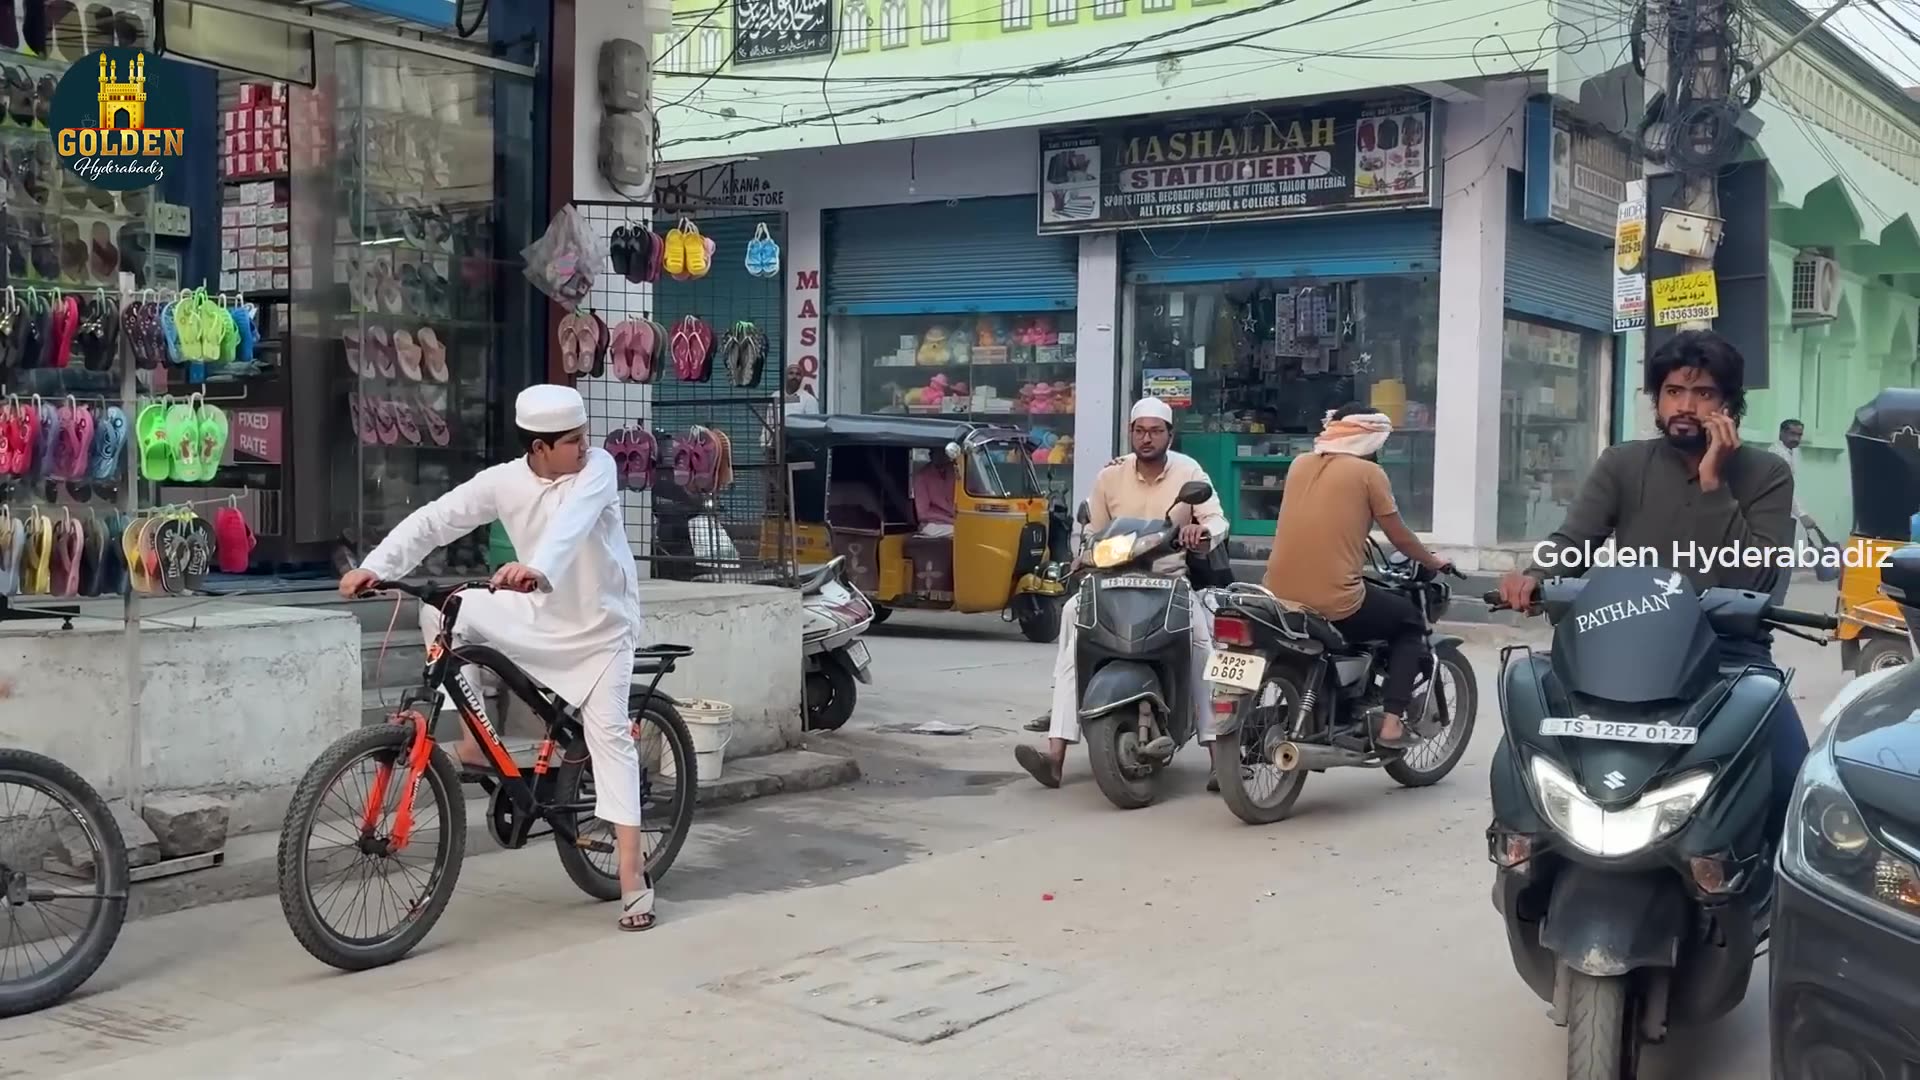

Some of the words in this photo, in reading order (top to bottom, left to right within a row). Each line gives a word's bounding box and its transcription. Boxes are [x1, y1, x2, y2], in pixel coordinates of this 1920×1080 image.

[1115, 117, 1337, 166] MASHALLAH
[752, 191, 784, 207] STORE
[1158, 188, 1204, 203] DECORATION
[1232, 184, 1250, 197] GIFT
[1307, 176, 1346, 190] MATERIAL
[1139, 205, 1154, 217] ALL
[1155, 203, 1182, 216] TYPES
[1183, 202, 1195, 214] OF
[1196, 200, 1231, 213] SCHOOL
[1241, 195, 1280, 209] COLLEGE
[1281, 193, 1307, 206] BAGS
[1658, 306, 1714, 321] 9133633981
[238, 411, 269, 430] FIXED
[240, 434, 267, 455] RATE
[1576, 593, 1671, 633] PATHAAN
[1211, 665, 1219, 677] D
[1221, 666, 1244, 681] 603
[454, 672, 501, 746] ROWDIES
[1595, 723, 1639, 738] 12EZ
[1645, 727, 1693, 741] 0127
